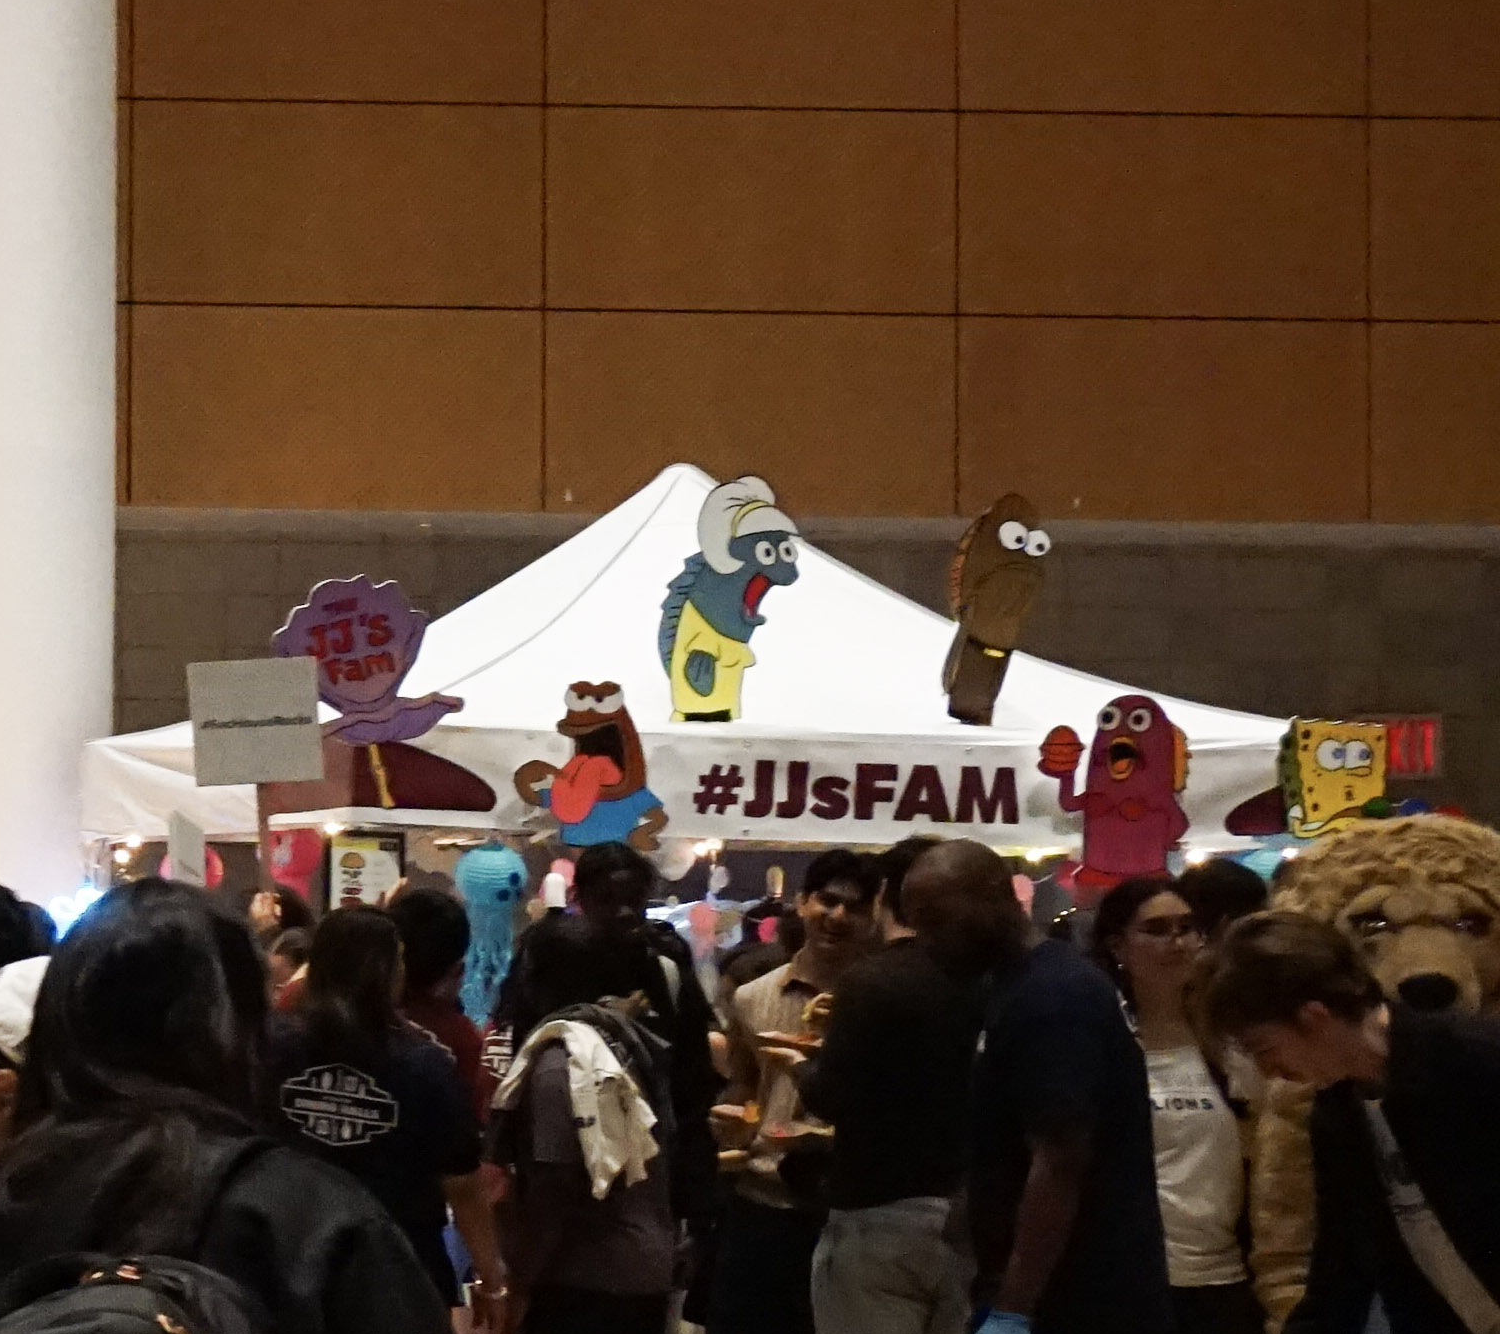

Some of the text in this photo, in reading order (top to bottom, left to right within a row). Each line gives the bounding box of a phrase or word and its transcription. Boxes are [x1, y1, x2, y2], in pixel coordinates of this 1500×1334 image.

[306, 614, 395, 660] JJ'S
[323, 650, 396, 686] Fam
[692, 759, 1020, 825] #JJsFAM
